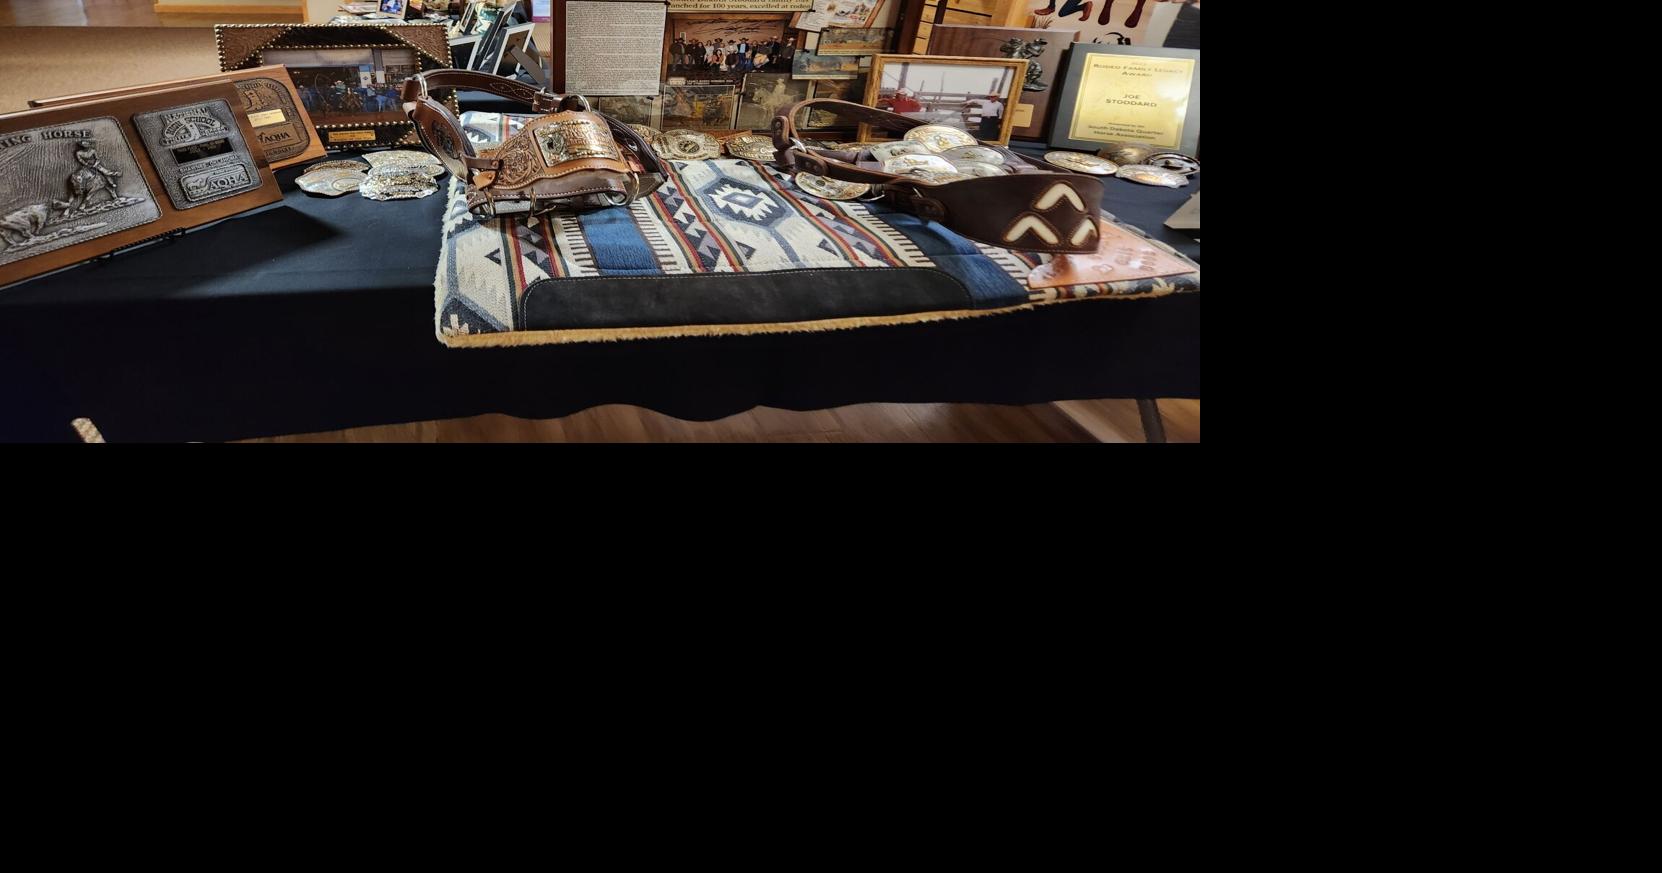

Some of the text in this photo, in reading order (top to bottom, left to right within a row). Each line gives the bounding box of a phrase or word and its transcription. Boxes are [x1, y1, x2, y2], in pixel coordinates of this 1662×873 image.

[1105, 99, 1157, 107] STODDARD
[183, 116, 218, 127] SCHOOL
[41, 129, 92, 140] HORSE
[264, 131, 290, 143] AQHA
[208, 174, 247, 191] AQHA
